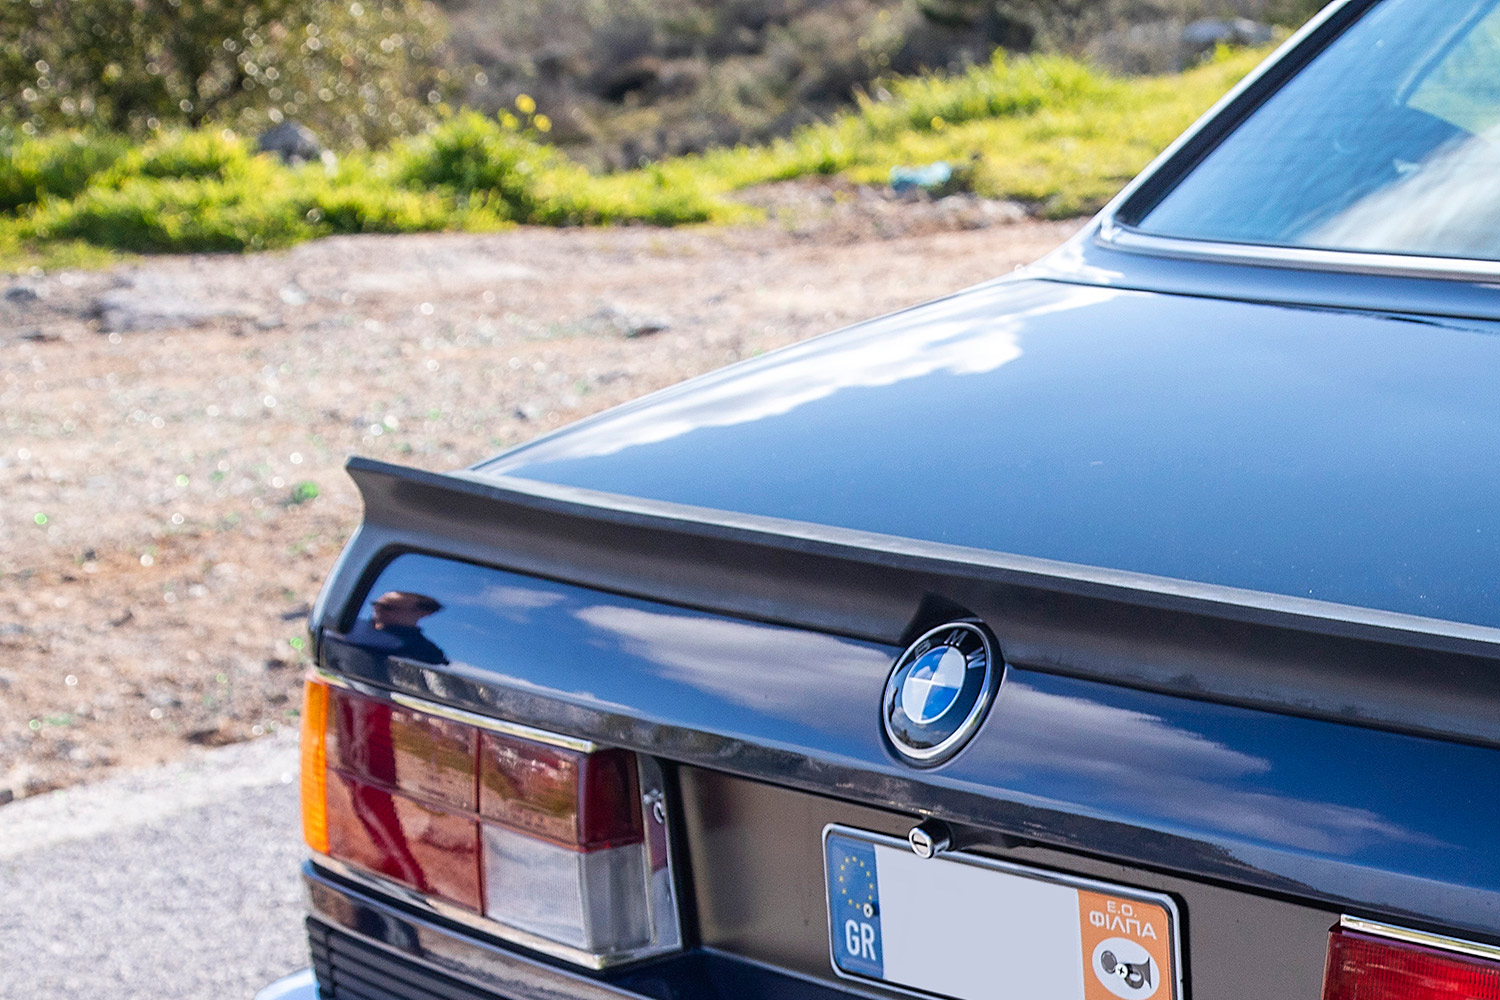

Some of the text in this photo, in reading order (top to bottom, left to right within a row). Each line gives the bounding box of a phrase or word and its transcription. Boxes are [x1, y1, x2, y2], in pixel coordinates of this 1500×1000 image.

[914, 629, 986, 669] BMW
[845, 919, 876, 961] GR
[1089, 910, 1157, 940] ΦΙΛΠΑ
